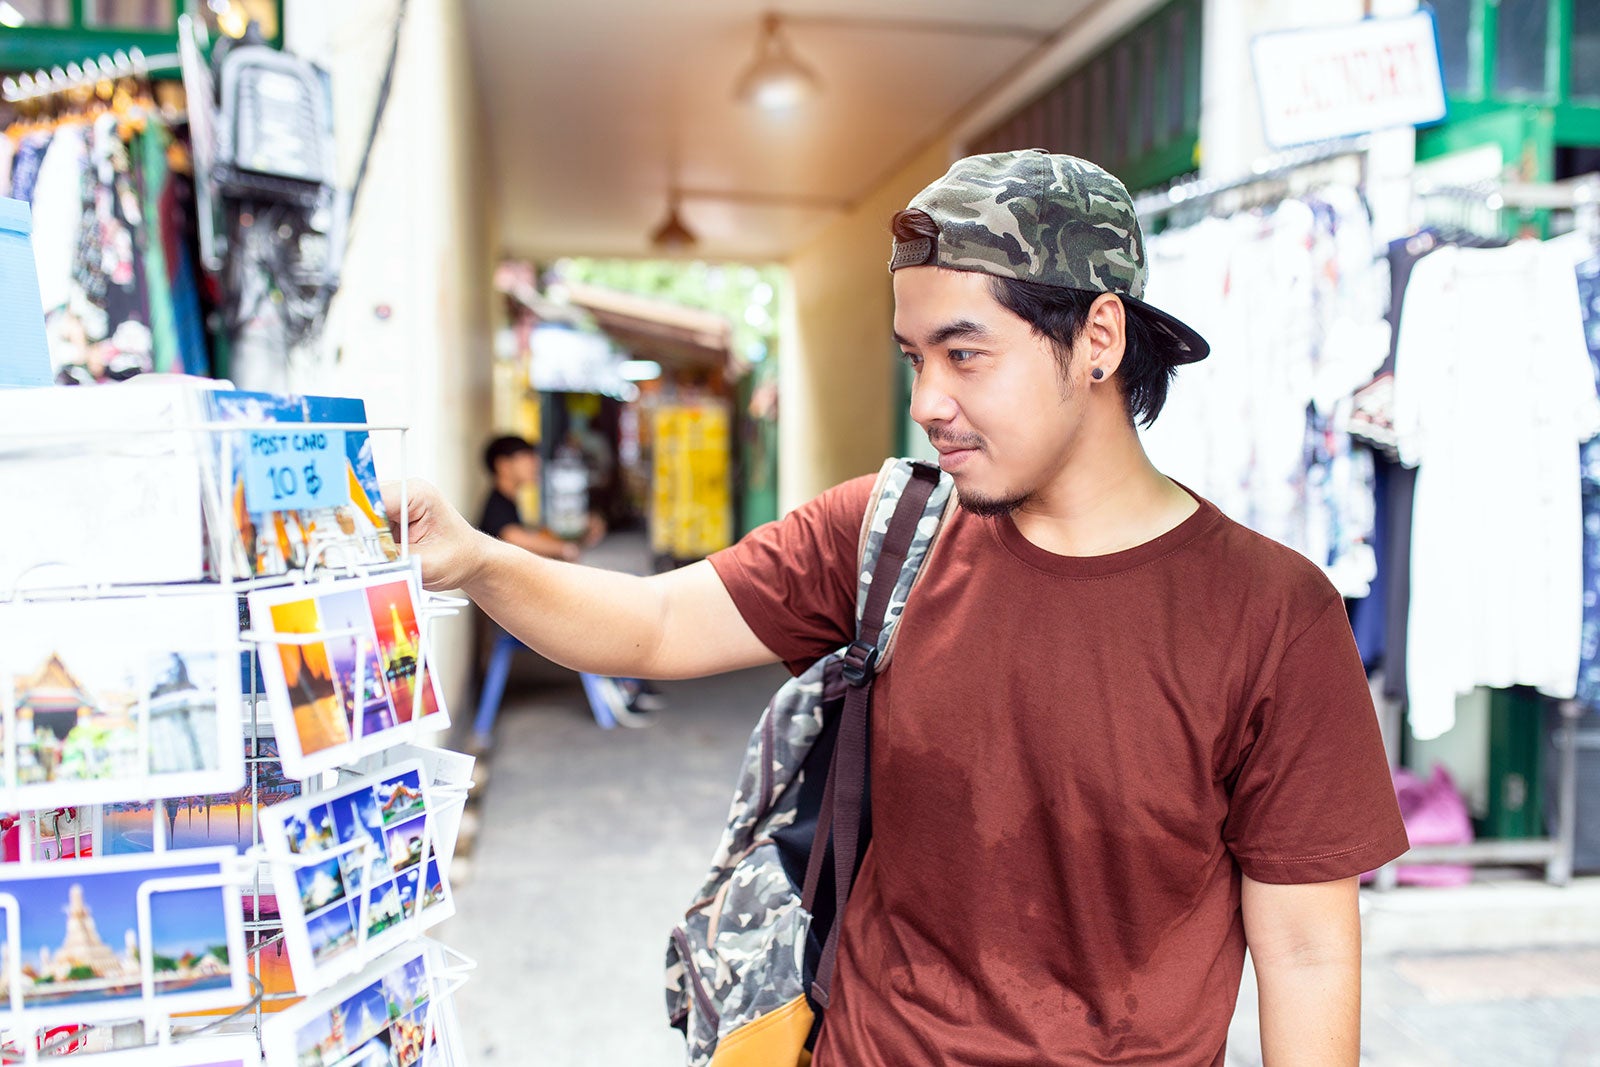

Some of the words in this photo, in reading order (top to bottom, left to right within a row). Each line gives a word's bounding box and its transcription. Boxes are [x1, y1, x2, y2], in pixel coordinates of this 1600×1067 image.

[251, 433, 287, 455] POST
[293, 433, 328, 452] CARD
[266, 466, 298, 500] 10
